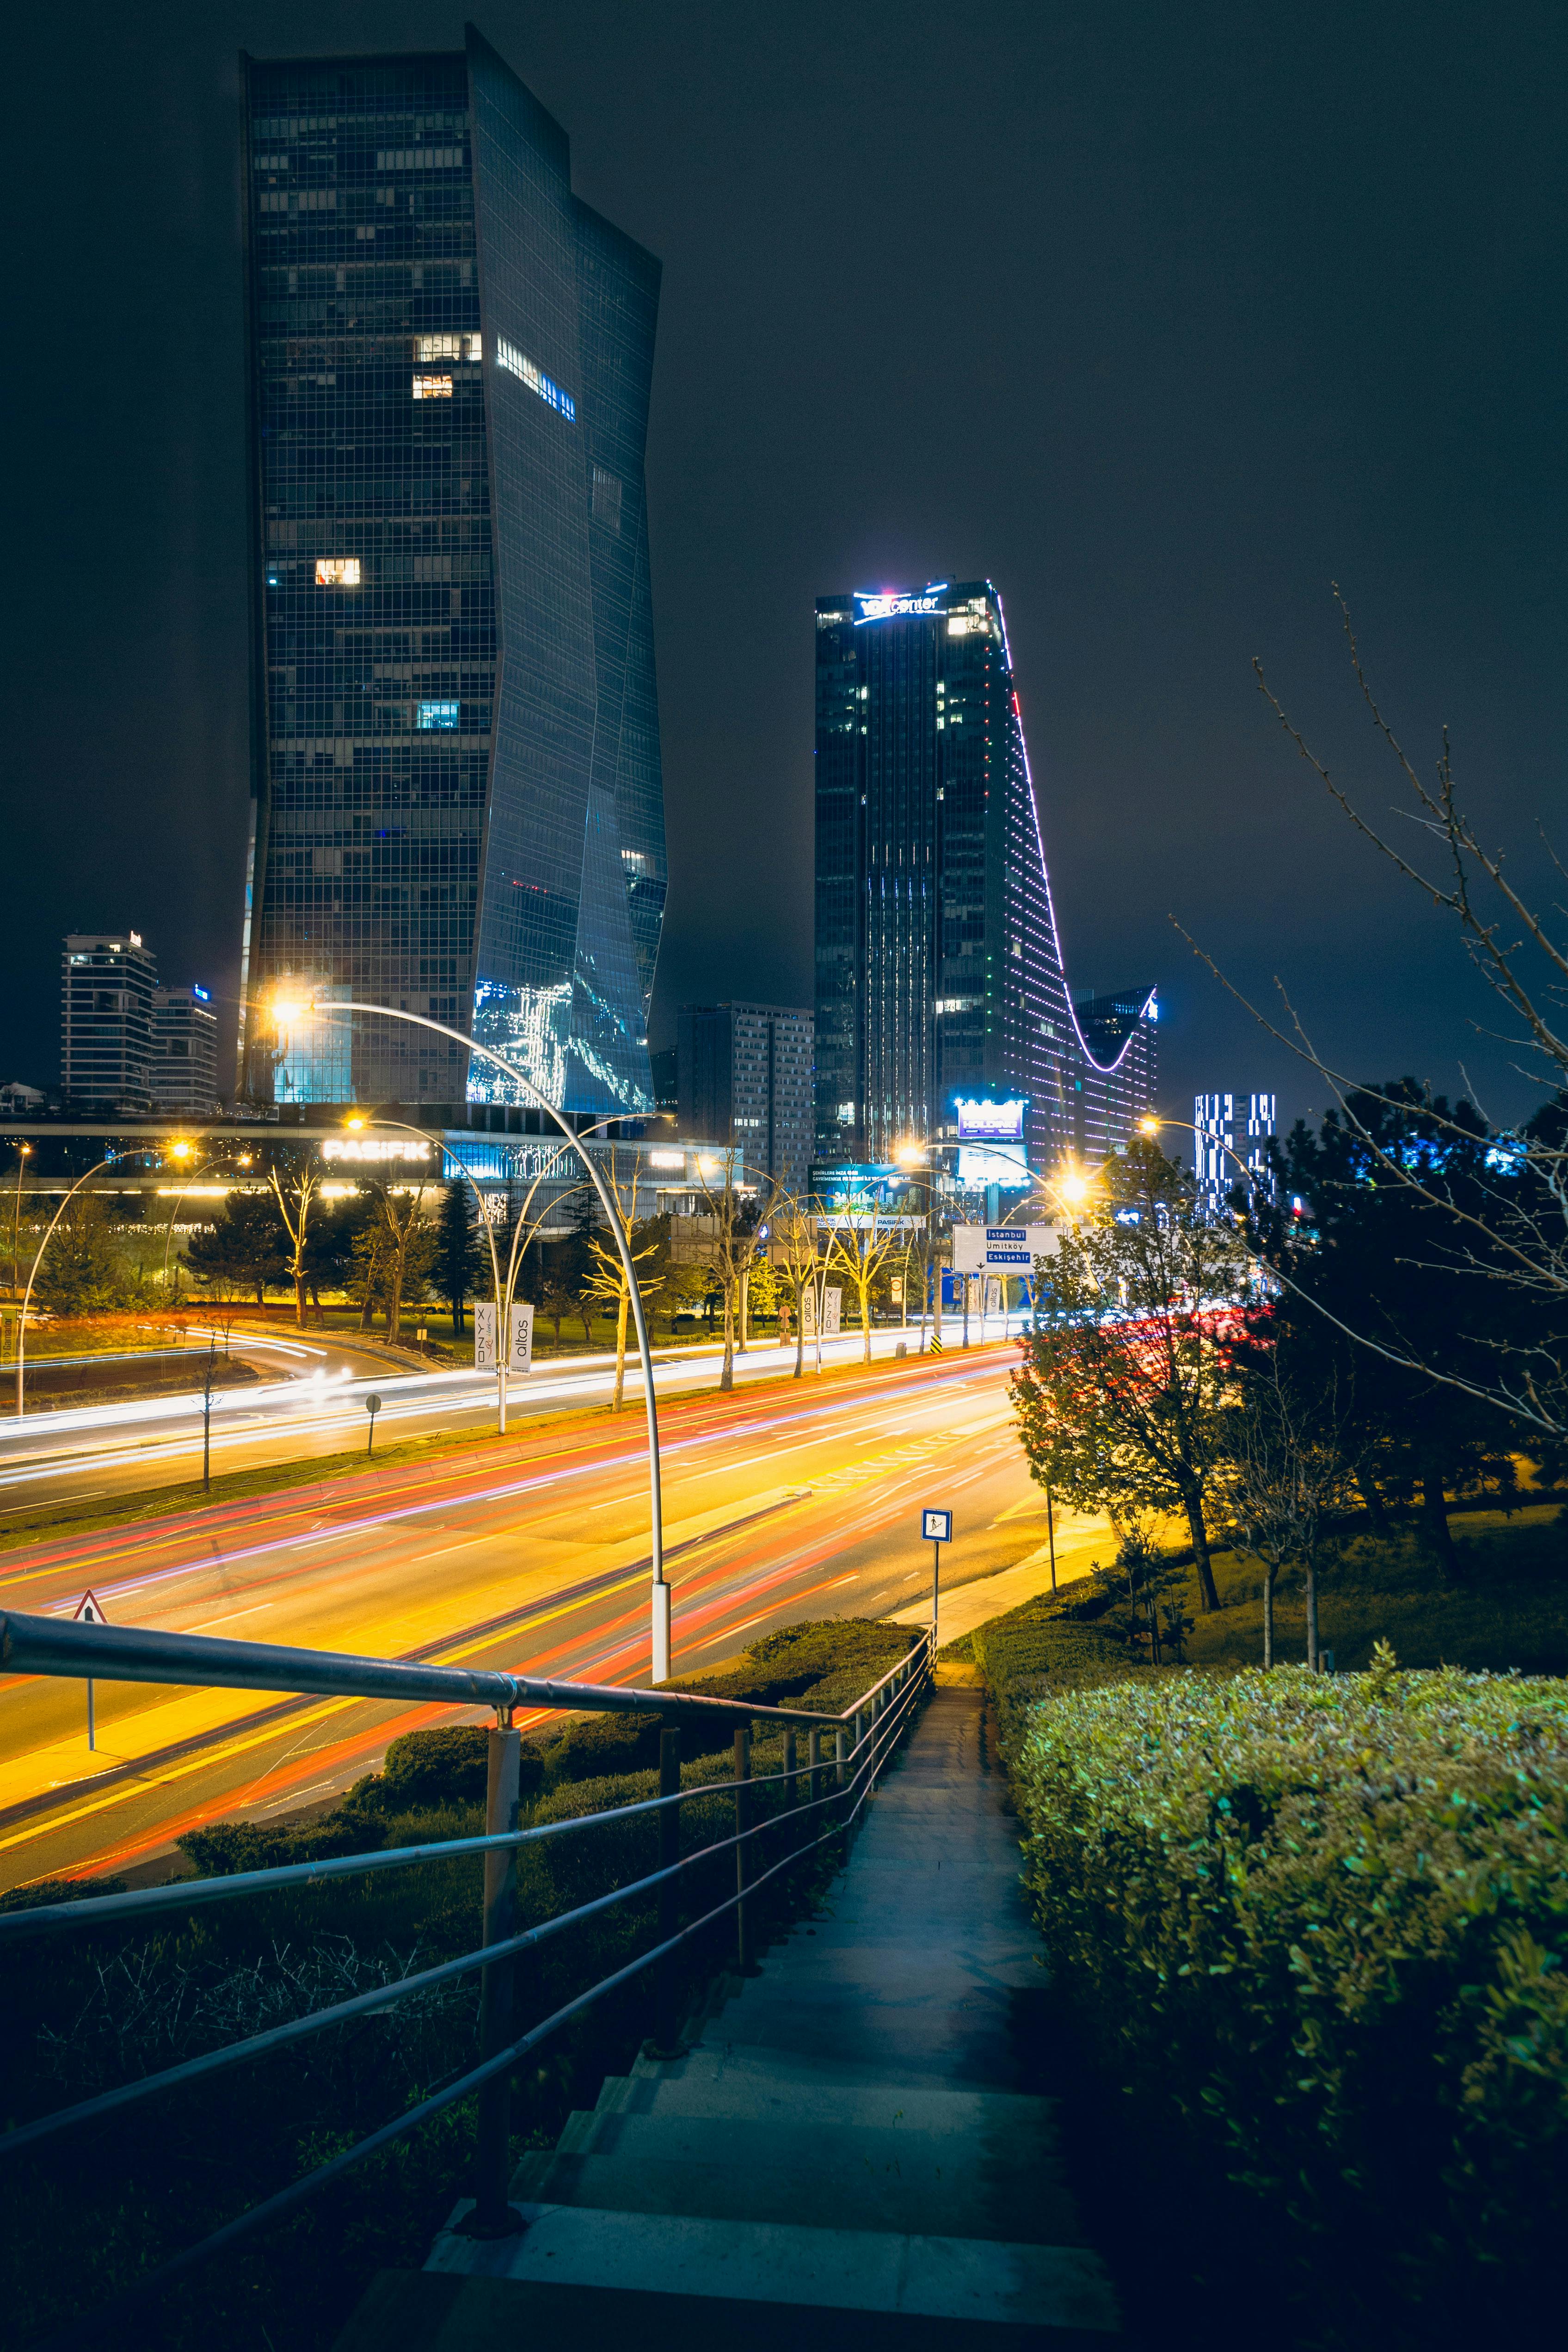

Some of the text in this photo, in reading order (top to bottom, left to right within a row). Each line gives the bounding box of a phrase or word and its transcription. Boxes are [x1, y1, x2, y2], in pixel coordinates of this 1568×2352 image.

[891, 597, 938, 612] center
[484, 1194, 510, 1209] NEXT
[987, 1242, 1023, 1250] Ümitköy
